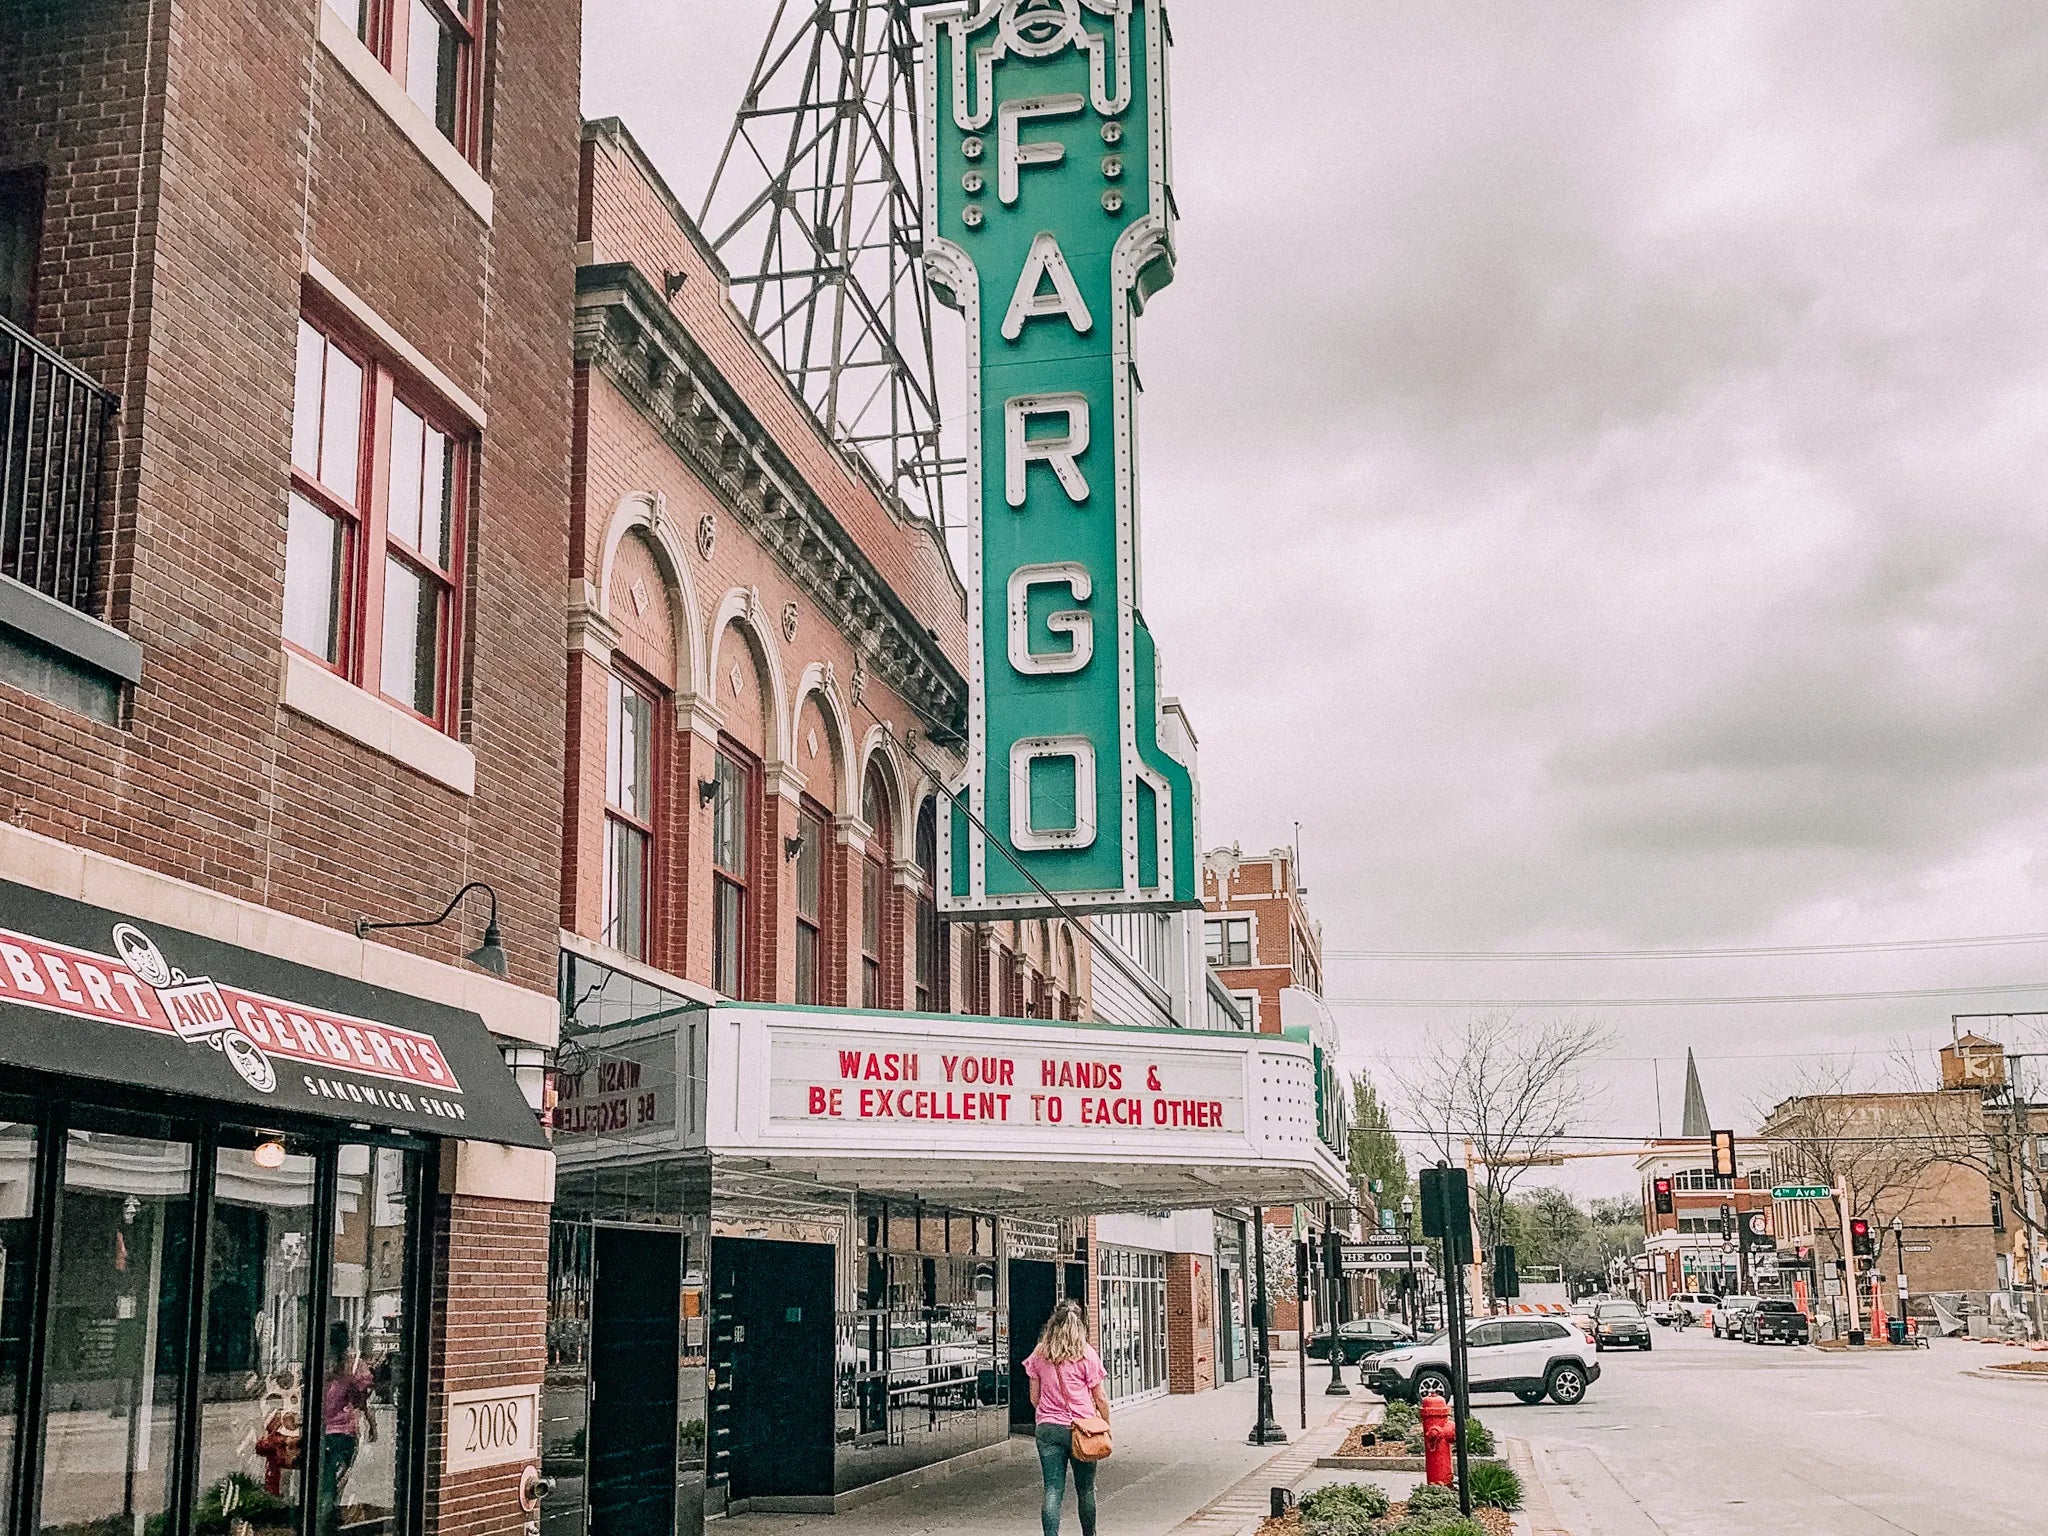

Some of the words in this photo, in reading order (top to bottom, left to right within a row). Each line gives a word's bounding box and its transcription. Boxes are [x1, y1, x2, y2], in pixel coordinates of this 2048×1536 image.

[997, 93, 1097, 853] FARGO
[0, 941, 152, 1019] BERT
[170, 991, 223, 1027] AND
[235, 999, 445, 1080] GERBERT'S
[839, 1051, 919, 1082] WASH
[941, 1055, 1015, 1087] YOUR
[1041, 1060, 1123, 1091] HANDS
[1146, 1065, 1162, 1091] &
[303, 1075, 416, 1112] SANDWICH
[419, 1096, 467, 1121] SHOP
[808, 1085, 842, 1117] BE
[859, 1089, 1012, 1122] EXCELLENT
[1031, 1095, 1063, 1124] TO
[1080, 1097, 1143, 1126] EACH
[1153, 1098, 1223, 1128] OTHER
[1795, 1188, 1816, 1197] Ave
[1821, 1188, 1829, 1196] N
[1341, 1253, 1365, 1262] THE
[1369, 1252, 1392, 1262] 400
[465, 1401, 518, 1453] 2008
